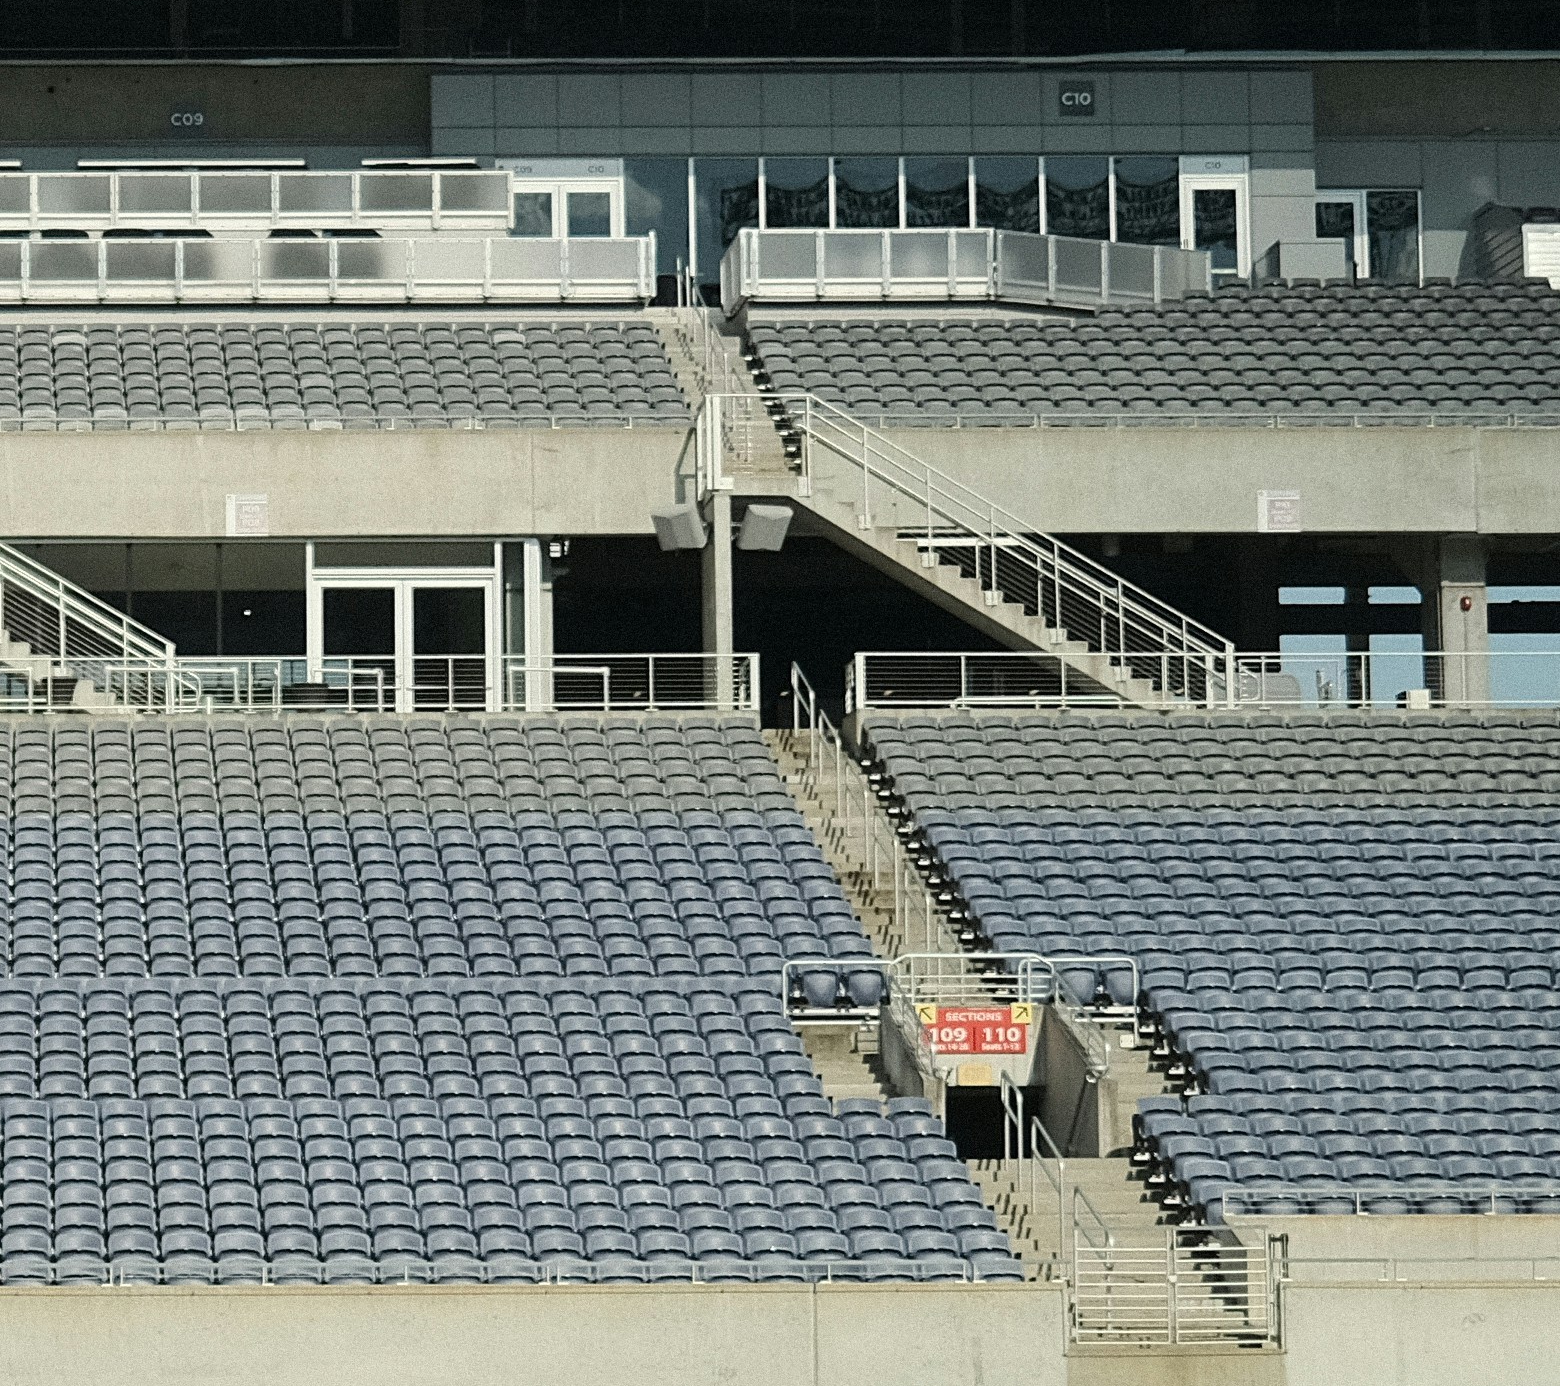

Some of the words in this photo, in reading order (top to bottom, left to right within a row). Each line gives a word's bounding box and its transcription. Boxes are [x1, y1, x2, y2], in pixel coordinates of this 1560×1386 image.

[1061, 93, 1091, 105] C10
[171, 113, 203, 126] C09
[945, 1013, 1002, 1022] SECTIONS
[930, 1028, 967, 1042] 109
[983, 1028, 1021, 1042] 110
